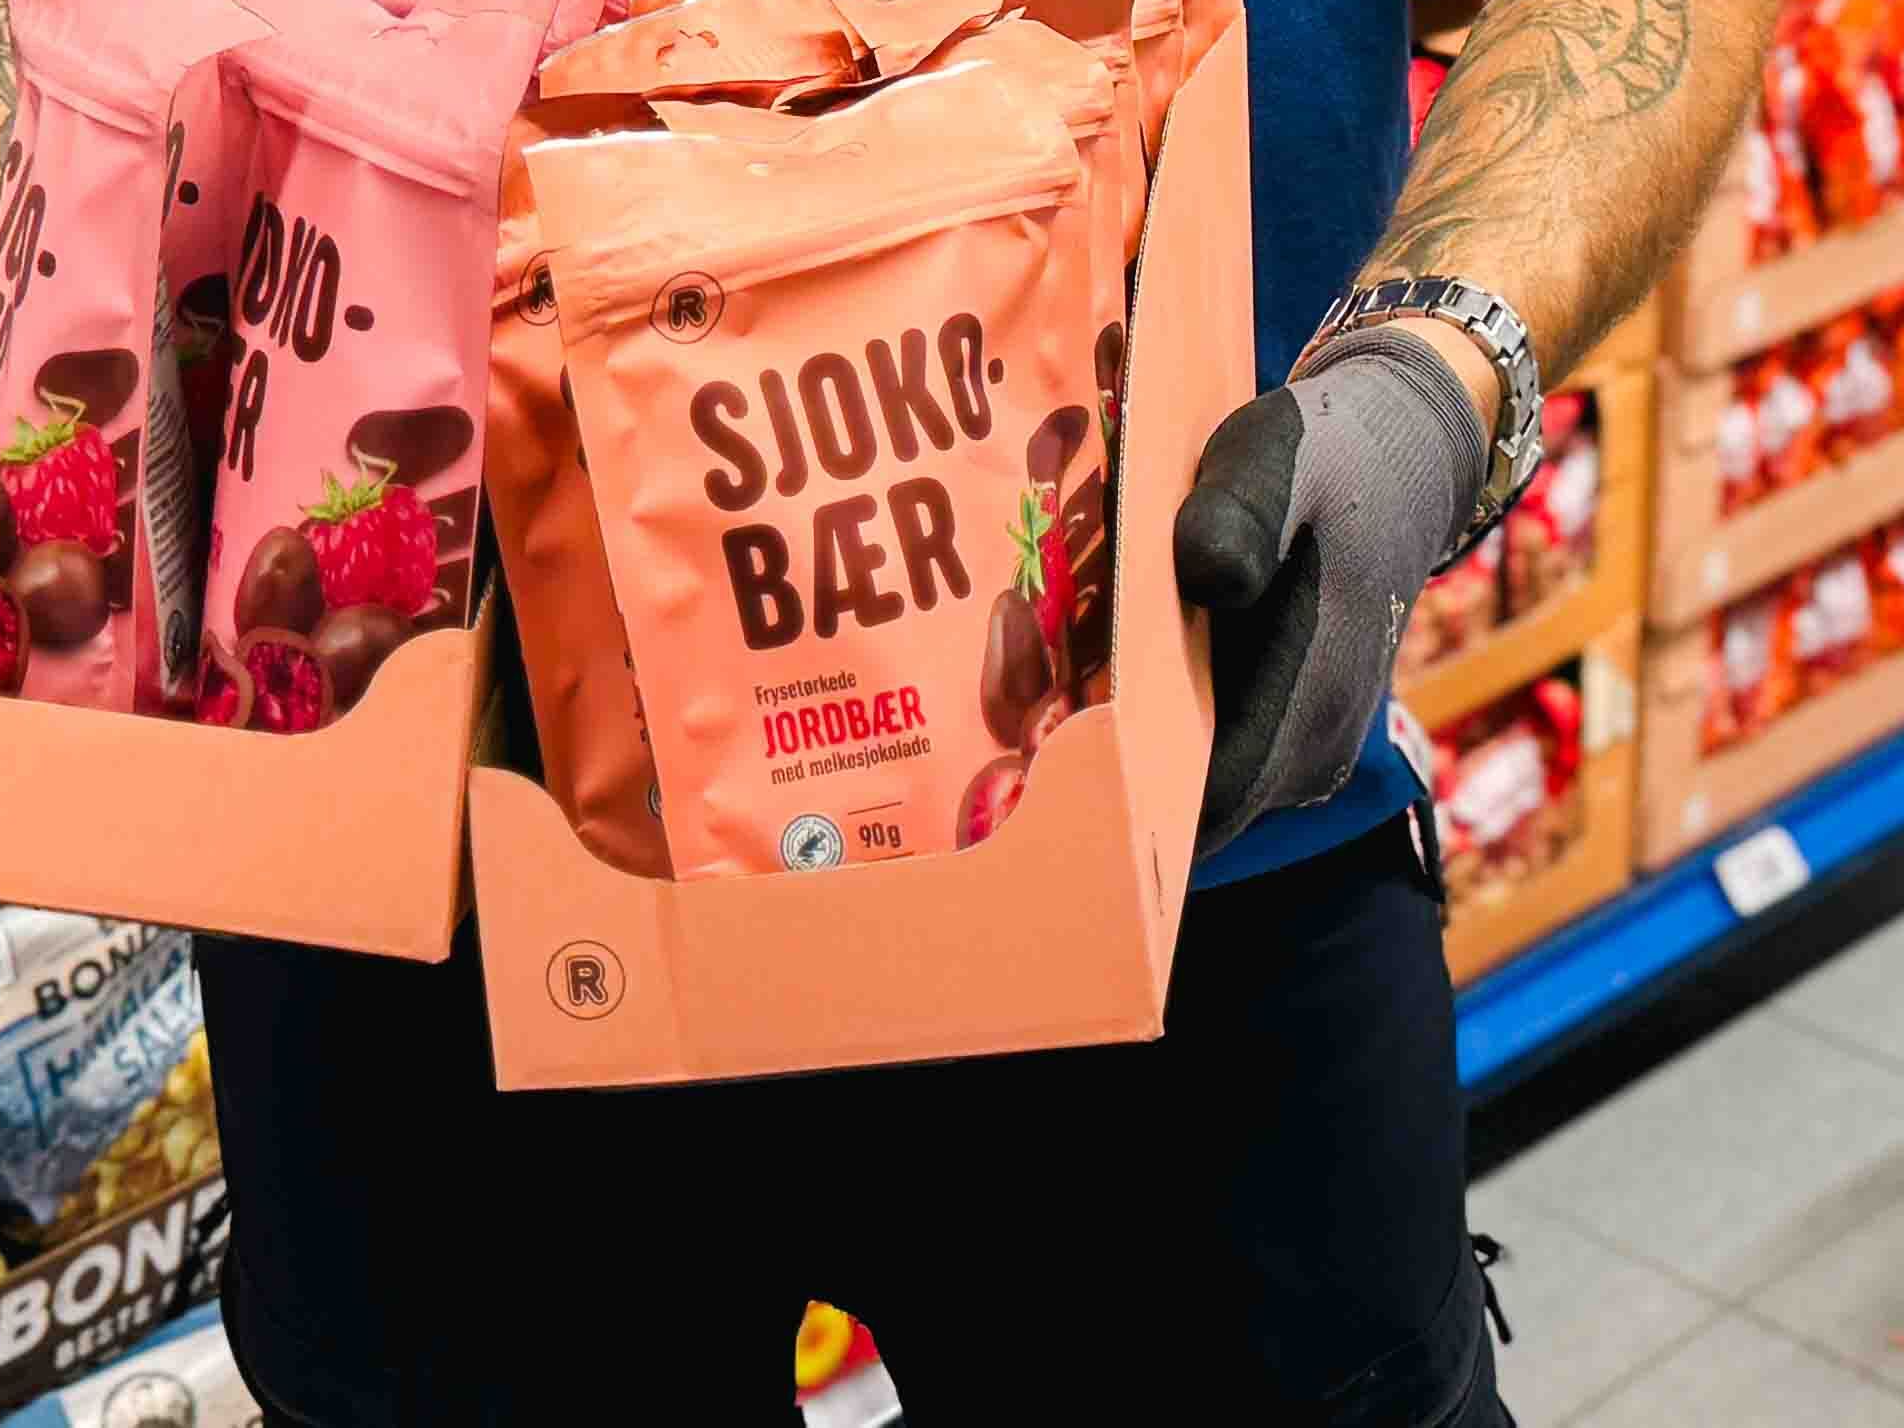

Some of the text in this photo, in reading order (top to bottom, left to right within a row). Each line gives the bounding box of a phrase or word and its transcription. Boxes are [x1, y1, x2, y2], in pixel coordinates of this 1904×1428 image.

[667, 285, 707, 332] R
[720, 476, 973, 652] BÆR
[753, 669, 857, 707] Frysetørkede
[762, 685, 927, 759] JORDBÆR
[770, 734, 932, 785] med melkesjokolade
[563, 958, 608, 1007] R
